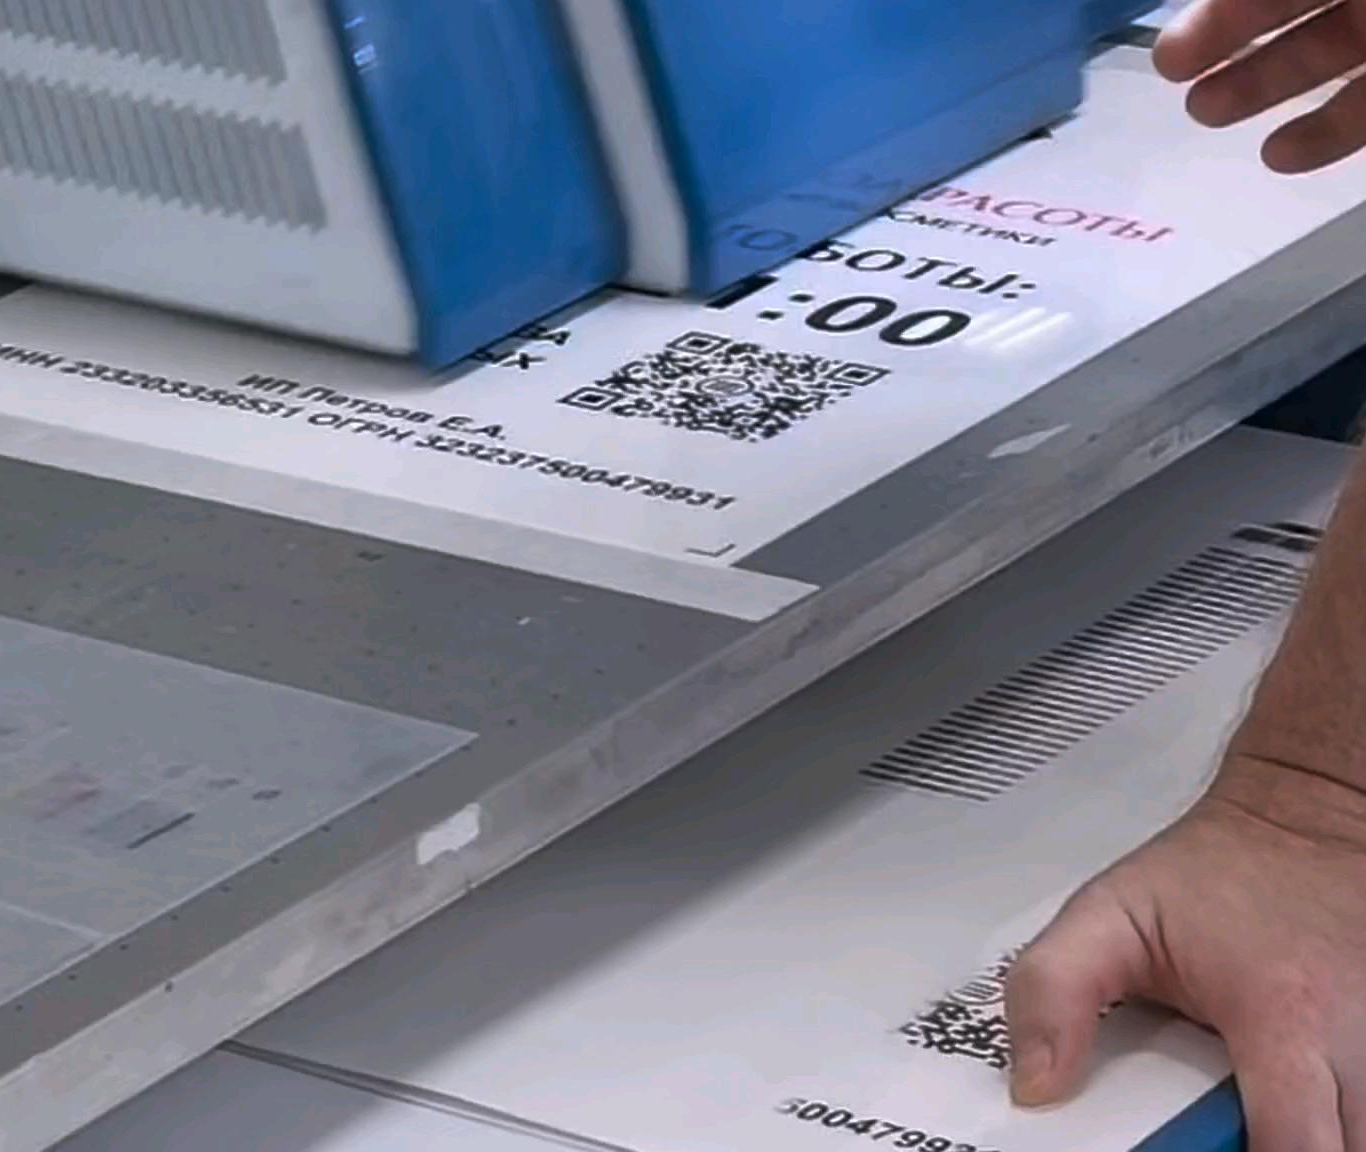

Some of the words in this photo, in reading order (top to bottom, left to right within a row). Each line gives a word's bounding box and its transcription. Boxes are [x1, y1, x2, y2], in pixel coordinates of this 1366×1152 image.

[888, 209, 1057, 247] СМЕТИКИ
[919, 186, 1174, 242] РАСОТЫ
[800, 239, 1037, 299] БОТЫ:
[237, 373, 301, 395] ИП
[297, 384, 435, 425] Петров
[308, 411, 415, 443] ОГРН
[414, 433, 736, 510] 323237500479931
